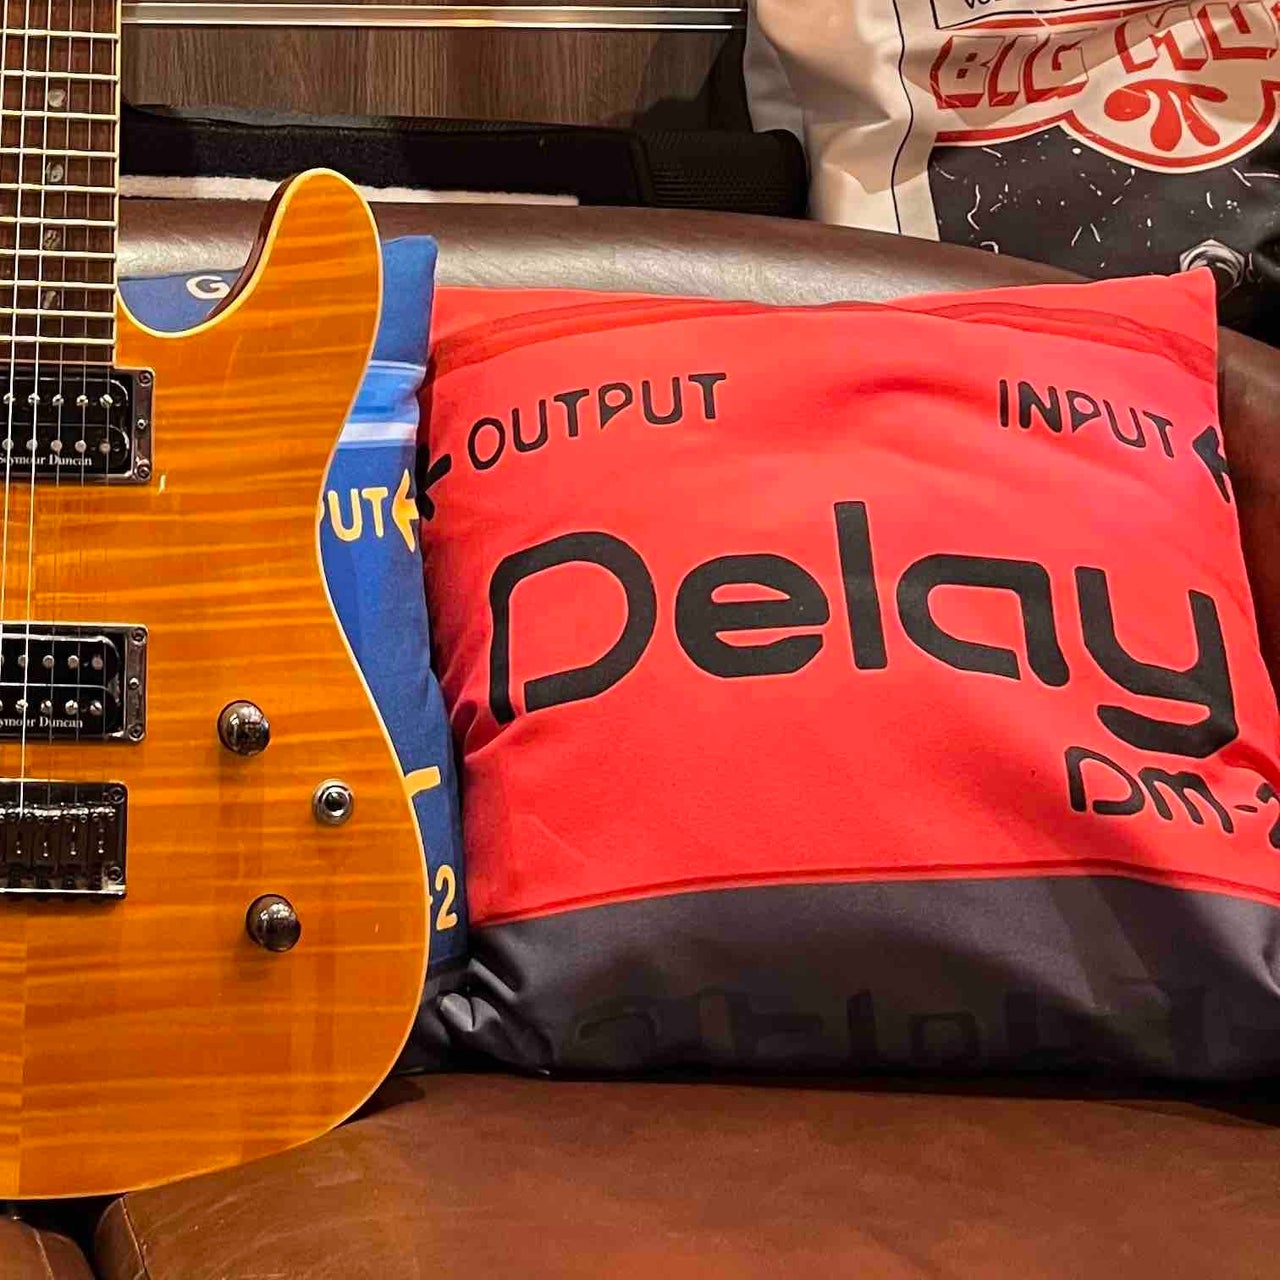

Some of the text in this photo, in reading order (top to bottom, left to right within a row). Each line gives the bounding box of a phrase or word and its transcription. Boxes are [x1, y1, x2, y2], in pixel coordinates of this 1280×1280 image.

[929, 0, 1280, 109] BIG MU
[48, 453, 93, 466] Duncan
[467, 372, 728, 471] OUTPUT
[998, 378, 1178, 459] INPUT
[489, 500, 1240, 758] Delay
[39, 715, 84, 729] Duncan
